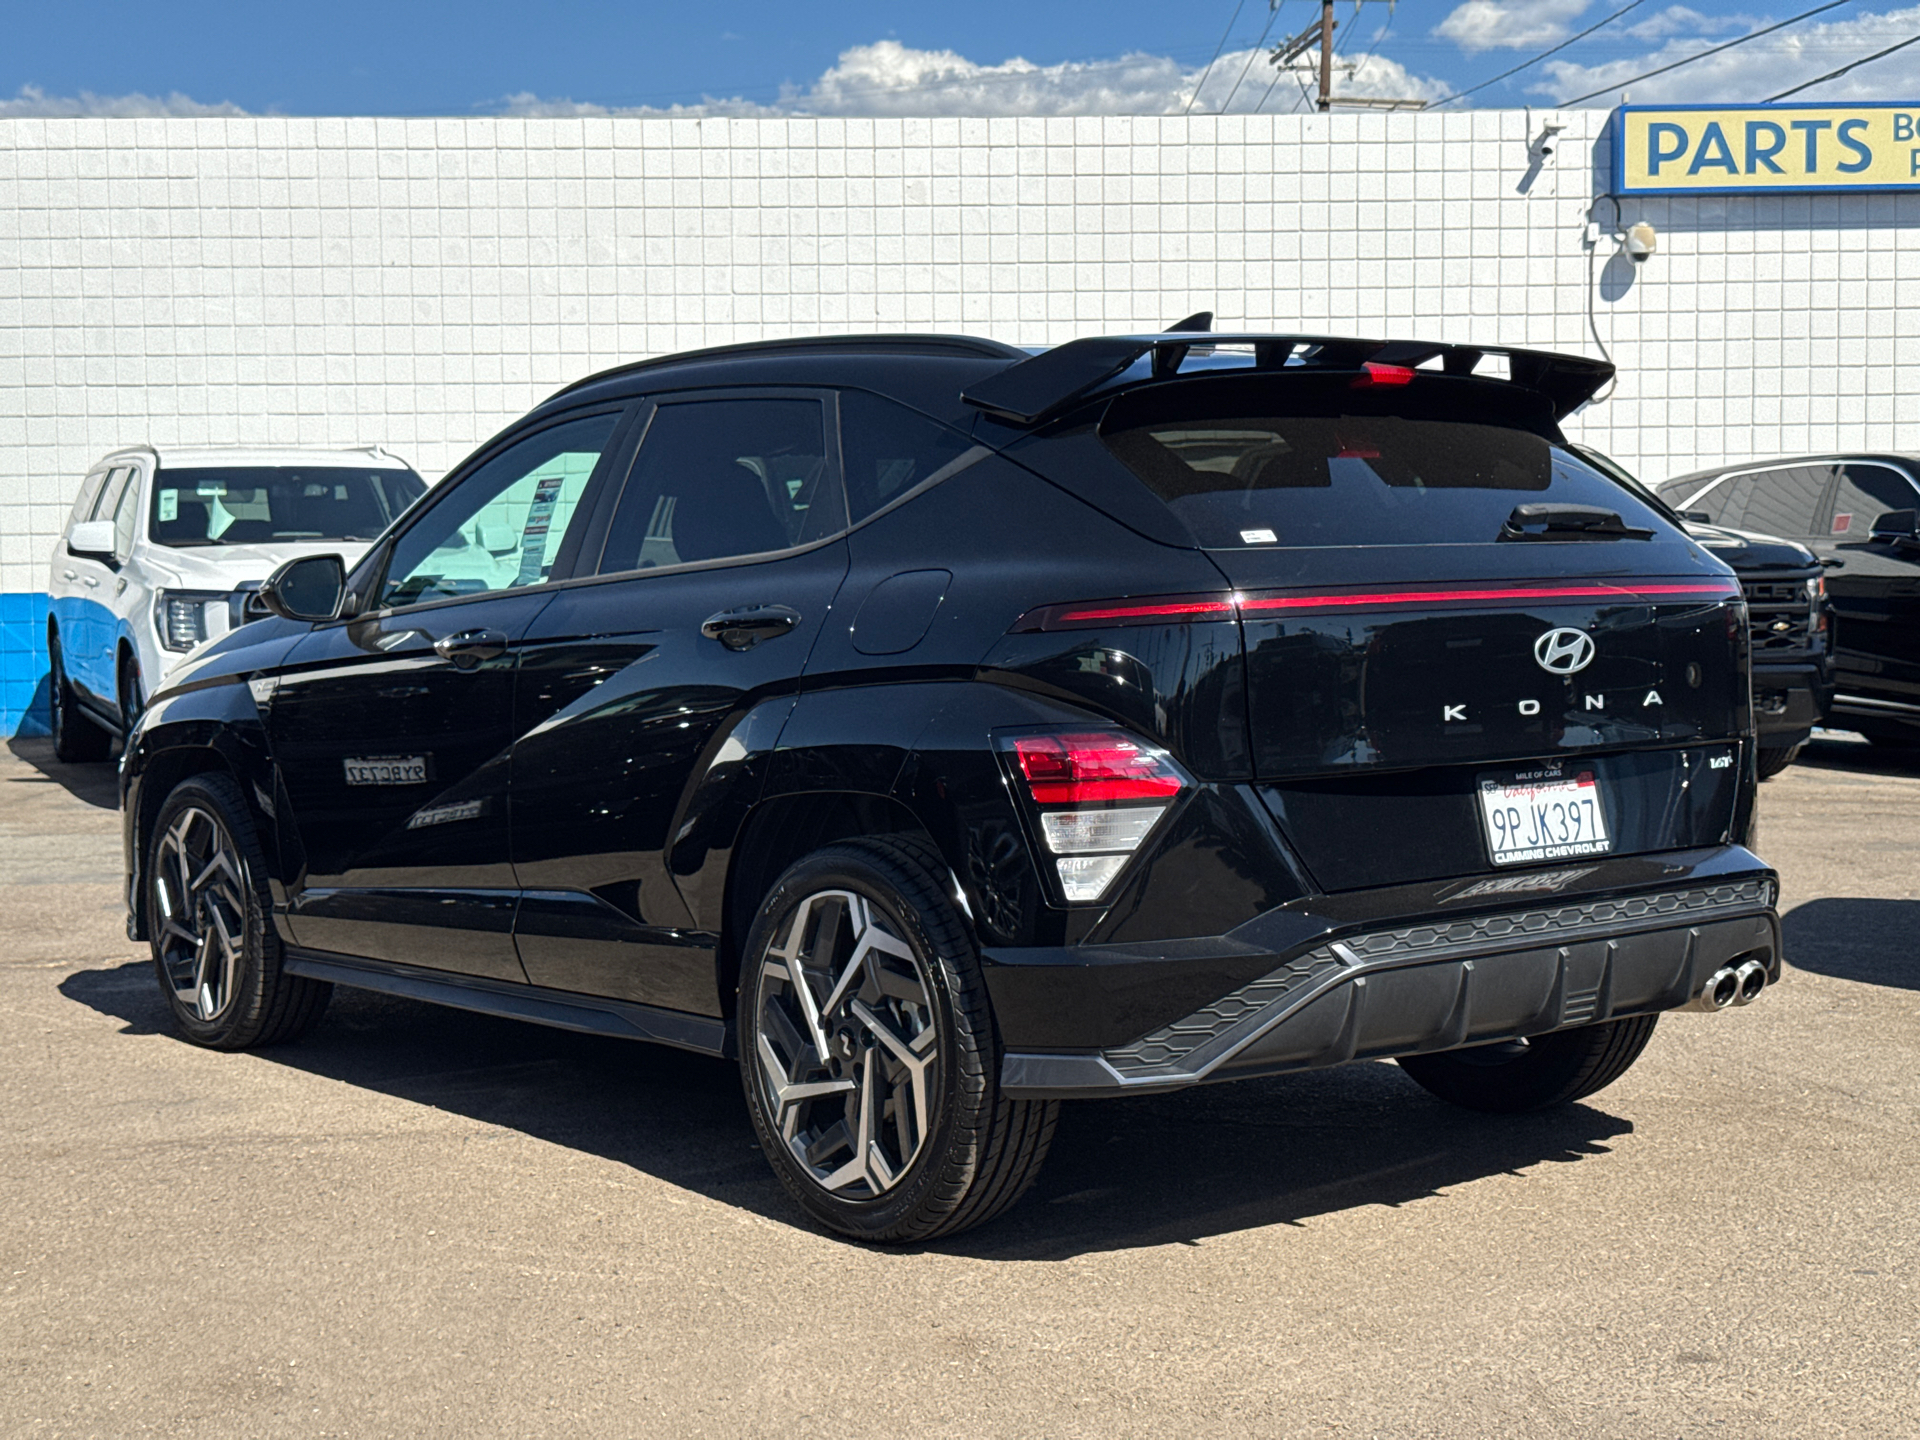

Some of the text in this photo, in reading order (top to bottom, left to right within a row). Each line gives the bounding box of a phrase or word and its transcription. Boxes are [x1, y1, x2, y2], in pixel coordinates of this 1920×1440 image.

[1893, 113, 1920, 142] B
[1648, 118, 1872, 176] PARTS
[1444, 691, 1663, 721] KONA
[1515, 769, 1562, 780] MILE OF CARS
[1492, 799, 1596, 850] 9PJK397
[1546, 840, 1610, 858] CHEVROLET
